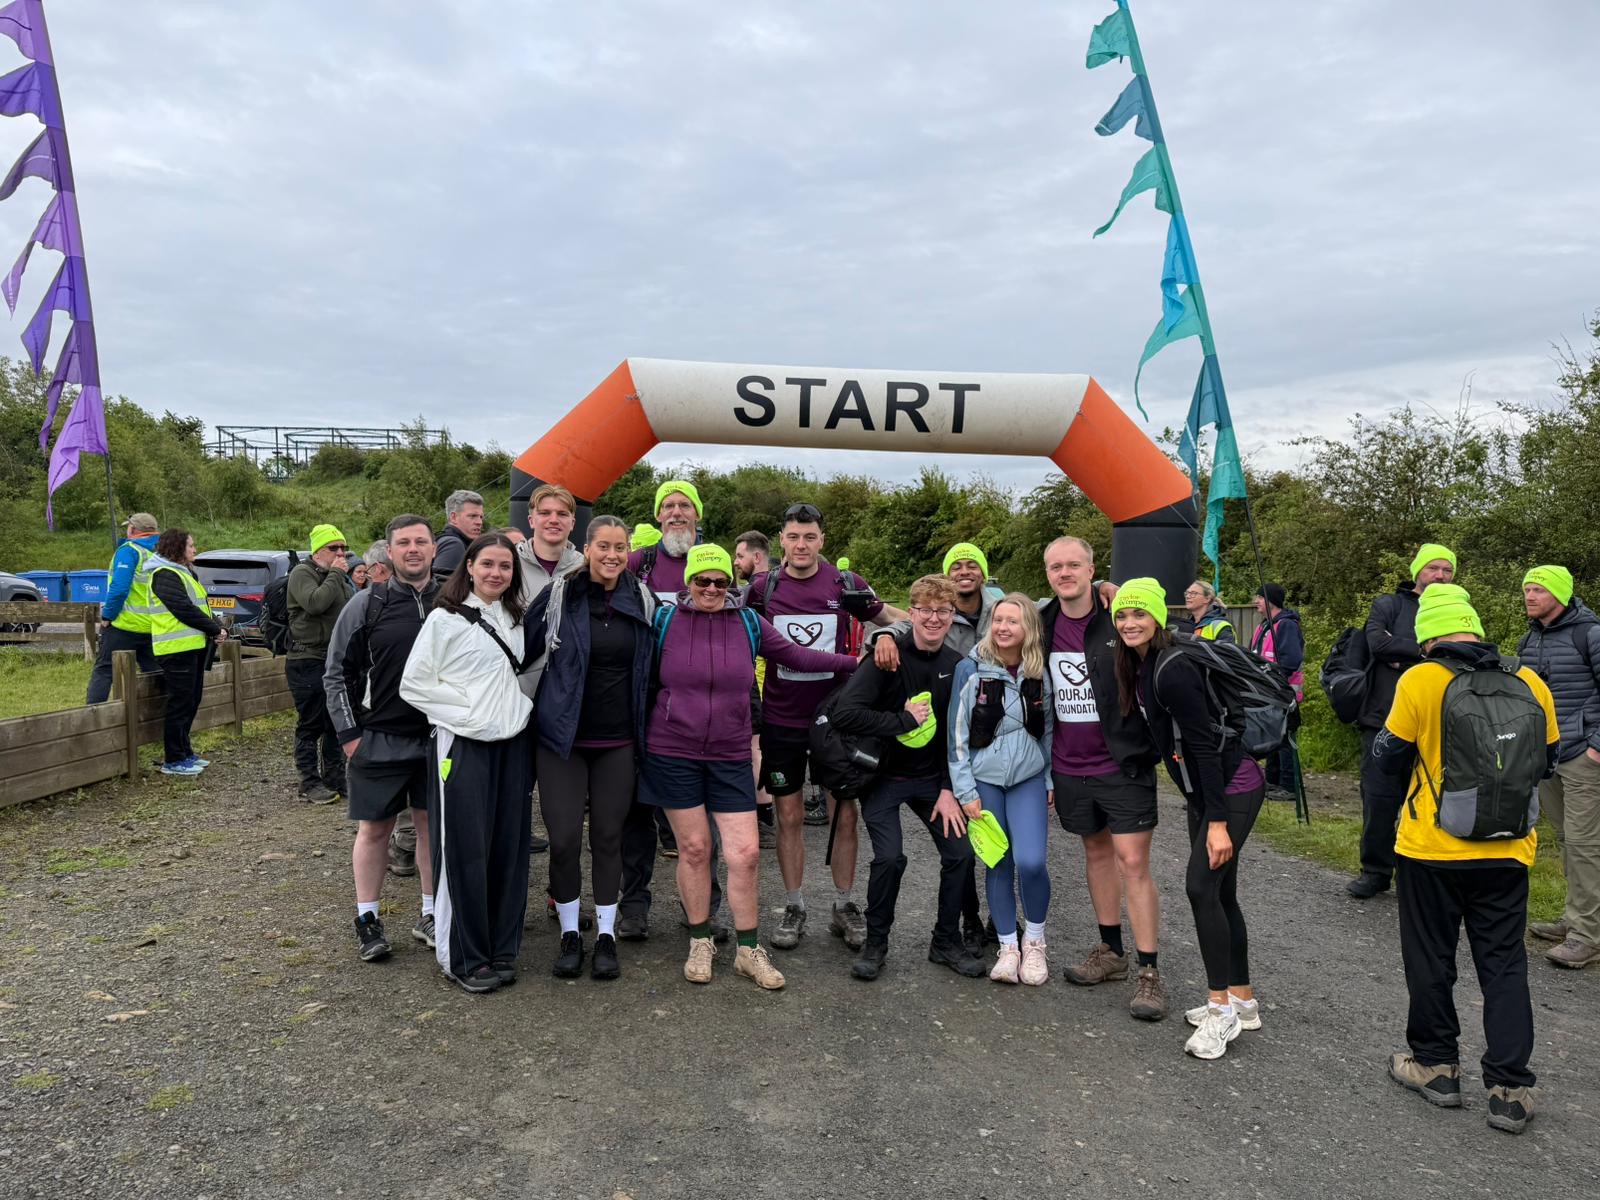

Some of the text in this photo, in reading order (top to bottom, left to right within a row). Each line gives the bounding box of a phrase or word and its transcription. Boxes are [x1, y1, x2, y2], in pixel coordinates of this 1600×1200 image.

[733, 375, 981, 434] START
[1058, 688, 1095, 701] OURJA
[1058, 703, 1096, 714] FOUNDATI
